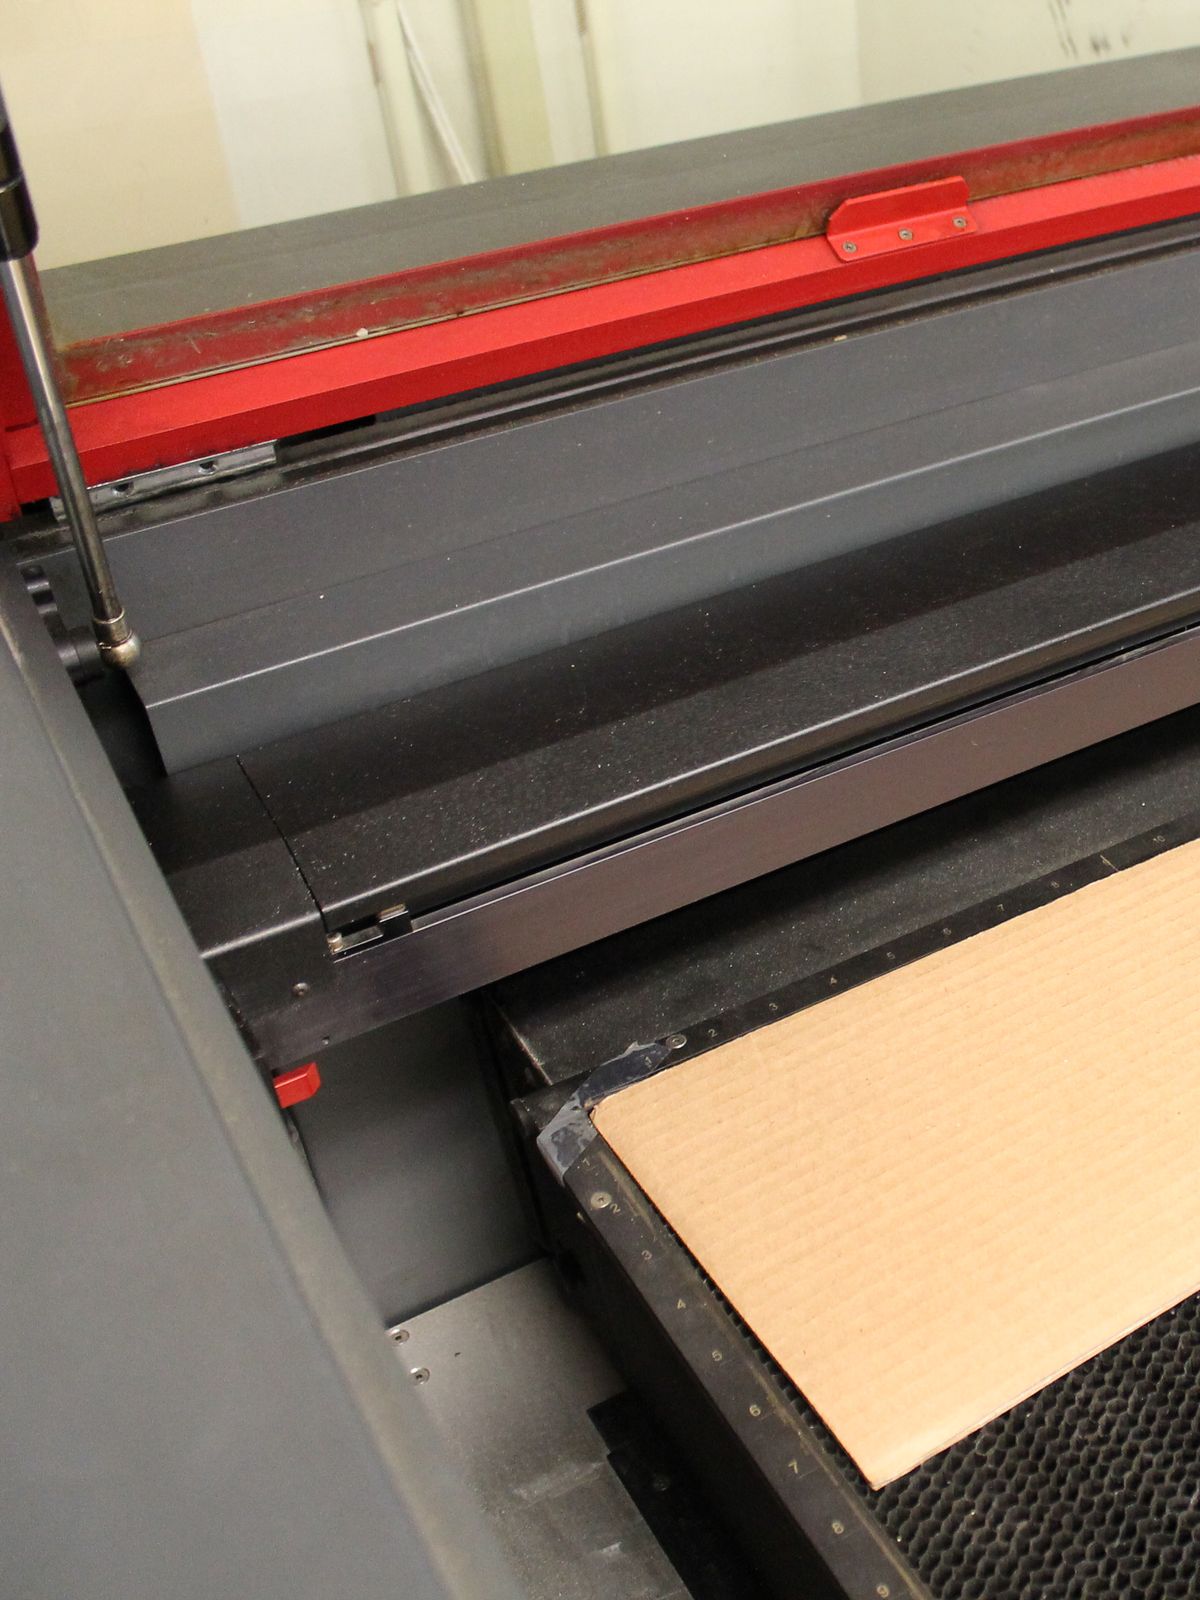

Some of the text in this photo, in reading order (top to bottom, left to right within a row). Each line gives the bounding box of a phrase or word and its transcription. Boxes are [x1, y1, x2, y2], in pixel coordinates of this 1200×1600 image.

[708, 1028, 718, 1038] 2
[769, 1002, 778, 1011] 3
[830, 975, 838, 985] 4
[886, 951, 896, 960] 5
[996, 903, 1005, 912] 7
[609, 1203, 621, 1214] 2
[641, 1249, 652, 1260] 3
[676, 1298, 687, 1310] 4
[711, 1350, 723, 1361] 5
[749, 1404, 761, 1417] 6
[787, 1458, 799, 1474] 7
[831, 1521, 844, 1534] 8
[876, 1584, 889, 1598] 9
